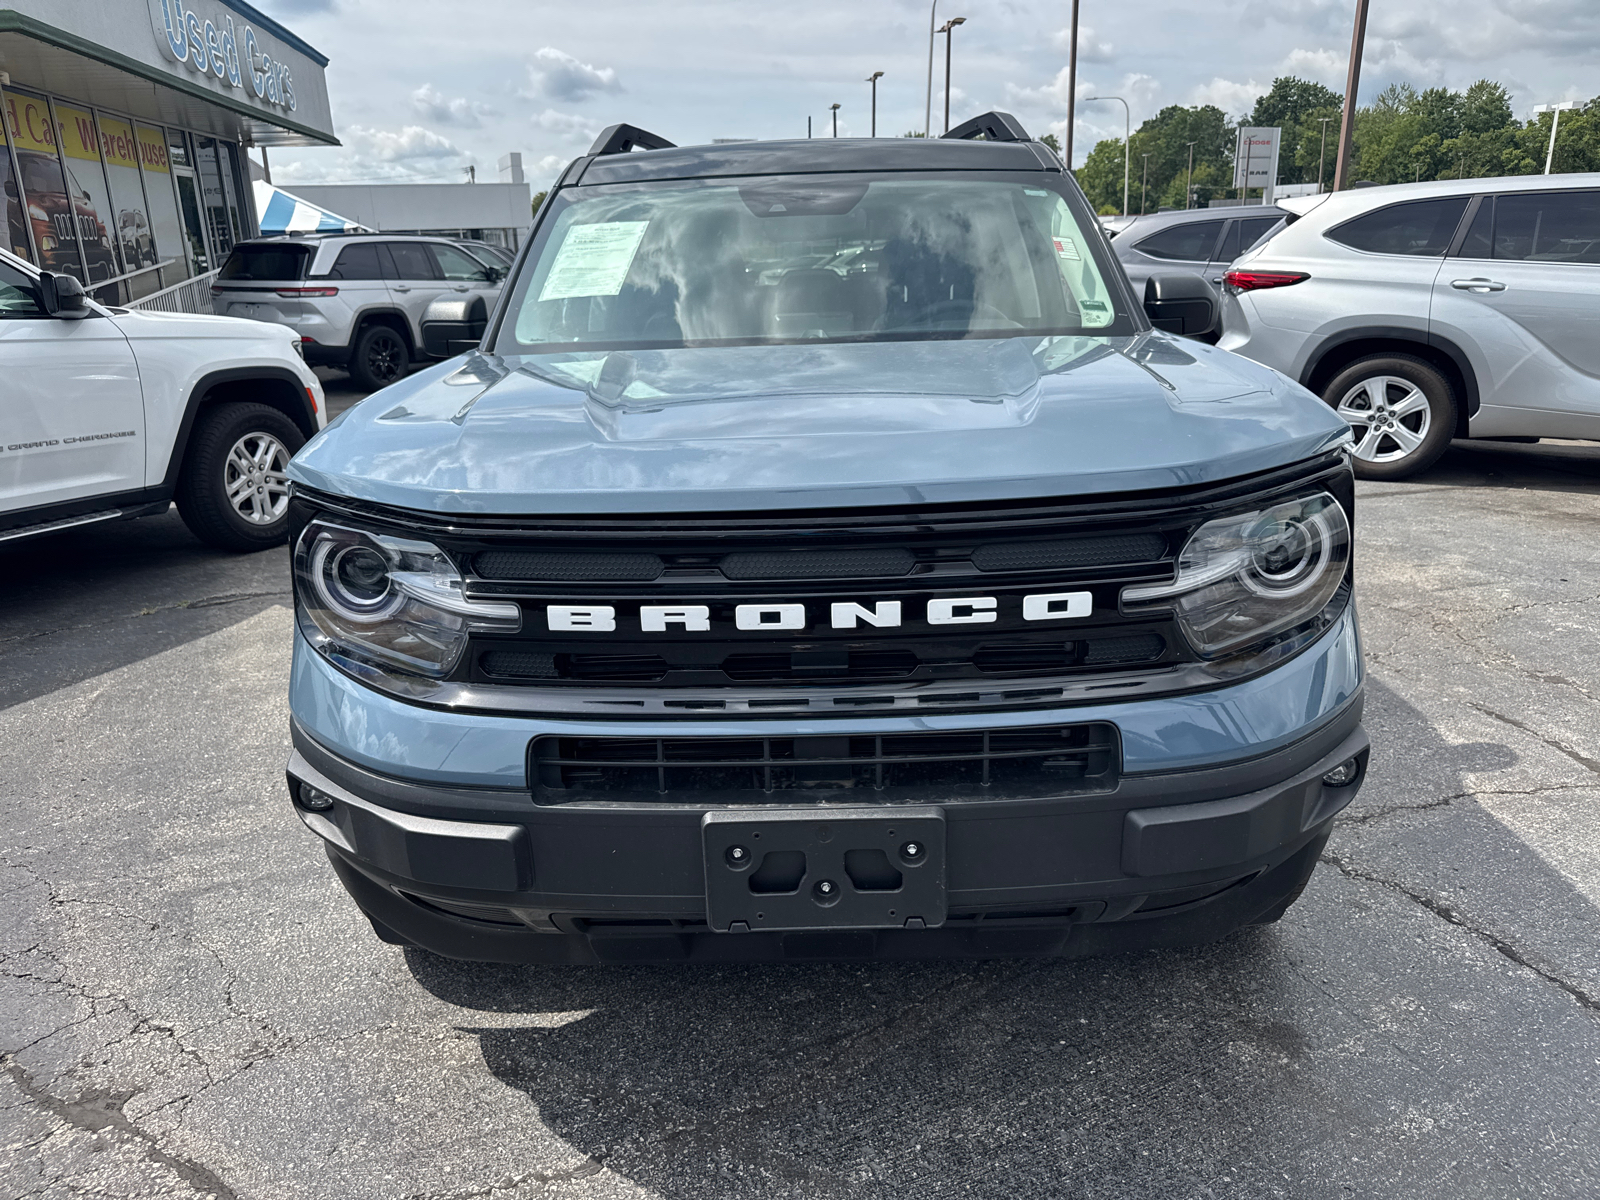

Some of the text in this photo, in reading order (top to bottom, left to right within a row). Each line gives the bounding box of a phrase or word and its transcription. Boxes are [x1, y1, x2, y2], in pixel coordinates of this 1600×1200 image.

[160, 0, 297, 112] Used Cars
[25, 103, 67, 148] Car
[7, 439, 60, 451] GRAND
[63, 430, 136, 444] CHEROKEE
[547, 591, 1093, 631] BRONCO
